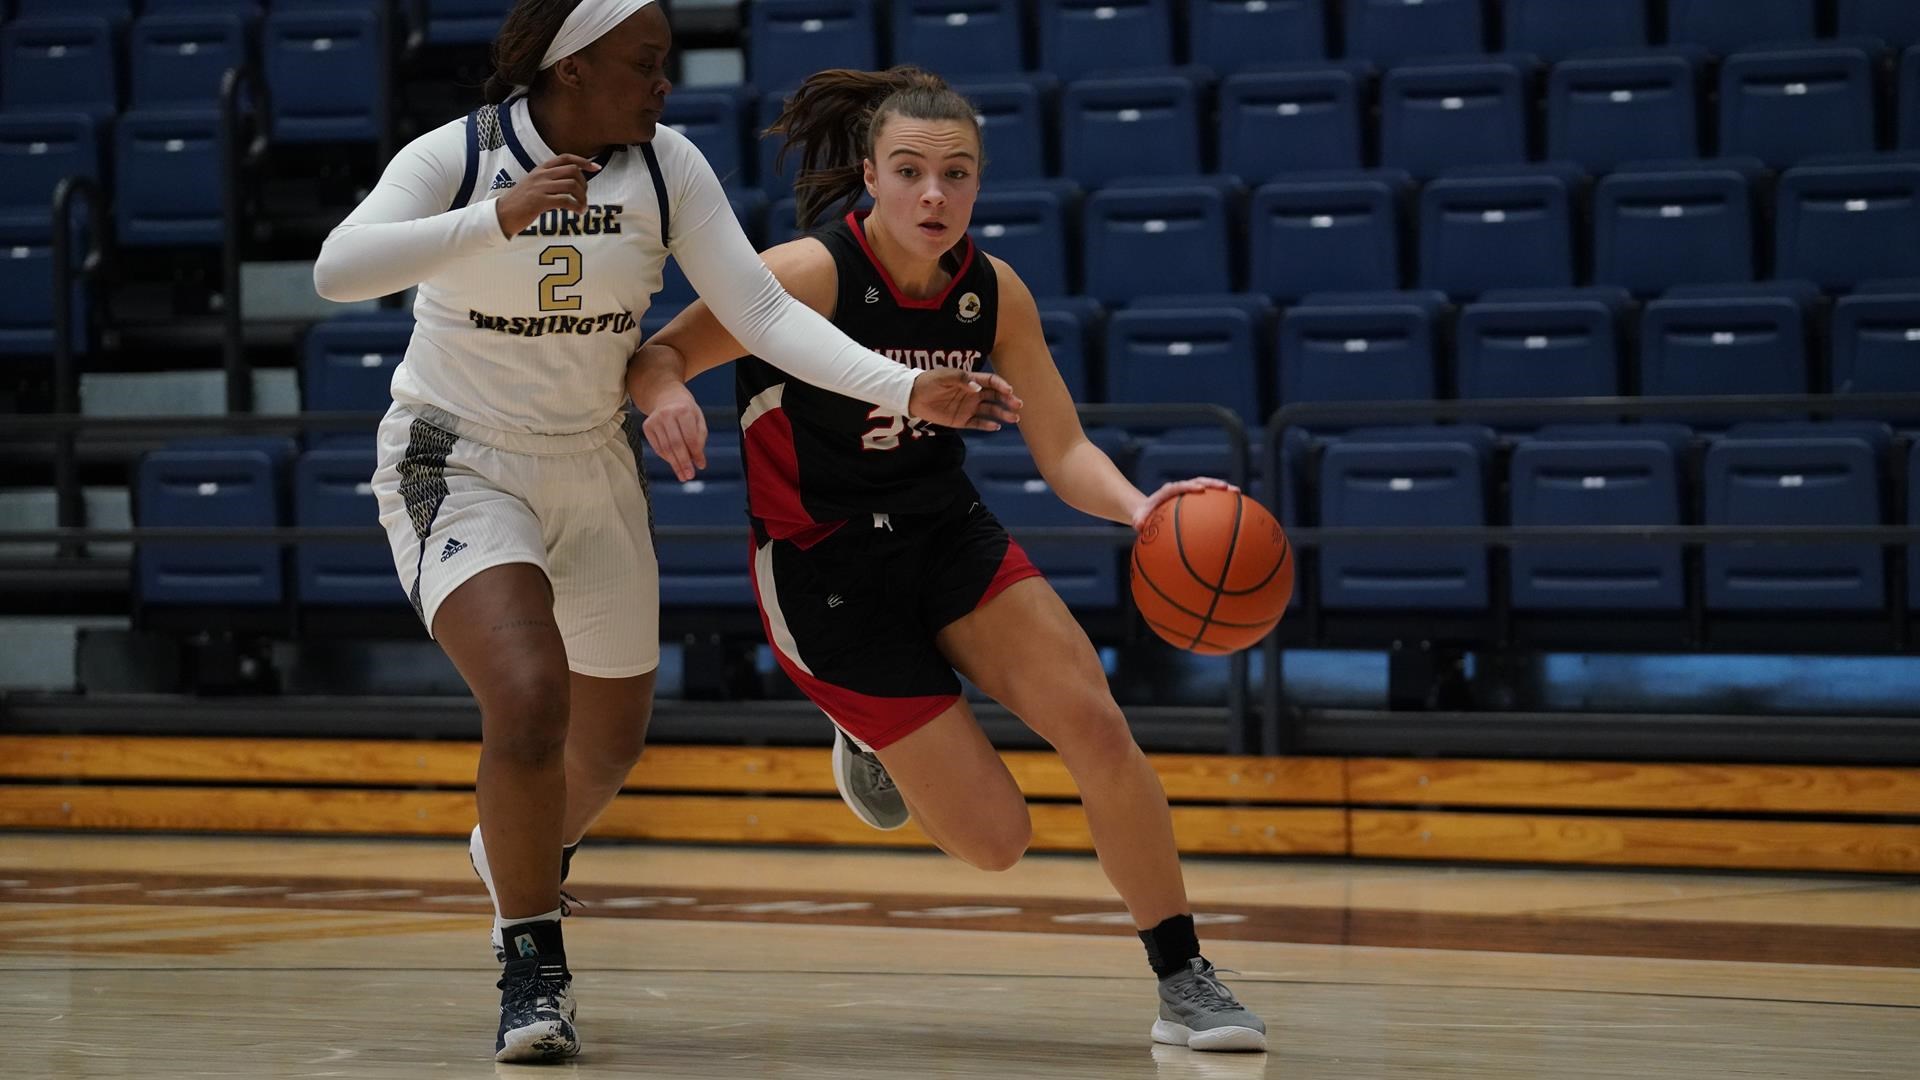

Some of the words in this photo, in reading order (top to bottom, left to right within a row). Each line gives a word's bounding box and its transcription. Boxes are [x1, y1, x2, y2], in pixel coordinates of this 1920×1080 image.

[490, 180, 517, 190] didas
[518, 204, 624, 236] ORGE
[538, 245, 582, 311] 2
[873, 349, 982, 373] VIDSON
[440, 542, 468, 563] adidas
